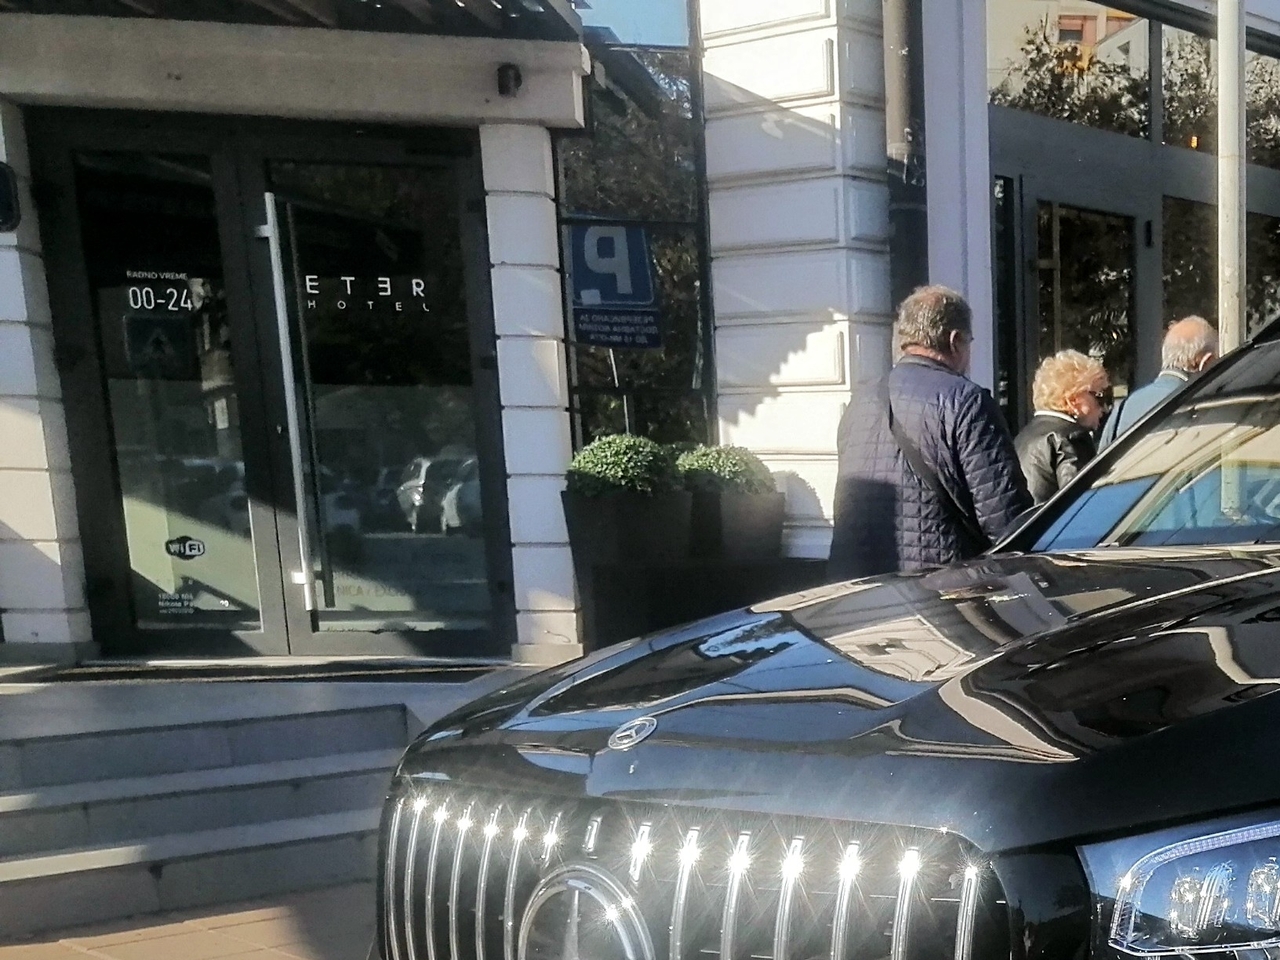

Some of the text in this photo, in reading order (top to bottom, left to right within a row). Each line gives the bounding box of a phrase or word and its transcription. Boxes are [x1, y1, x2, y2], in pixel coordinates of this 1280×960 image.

[126, 270, 157, 279] RADNO
[129, 286, 193, 311] 00-24
[307, 300, 430, 312] HOTEL
